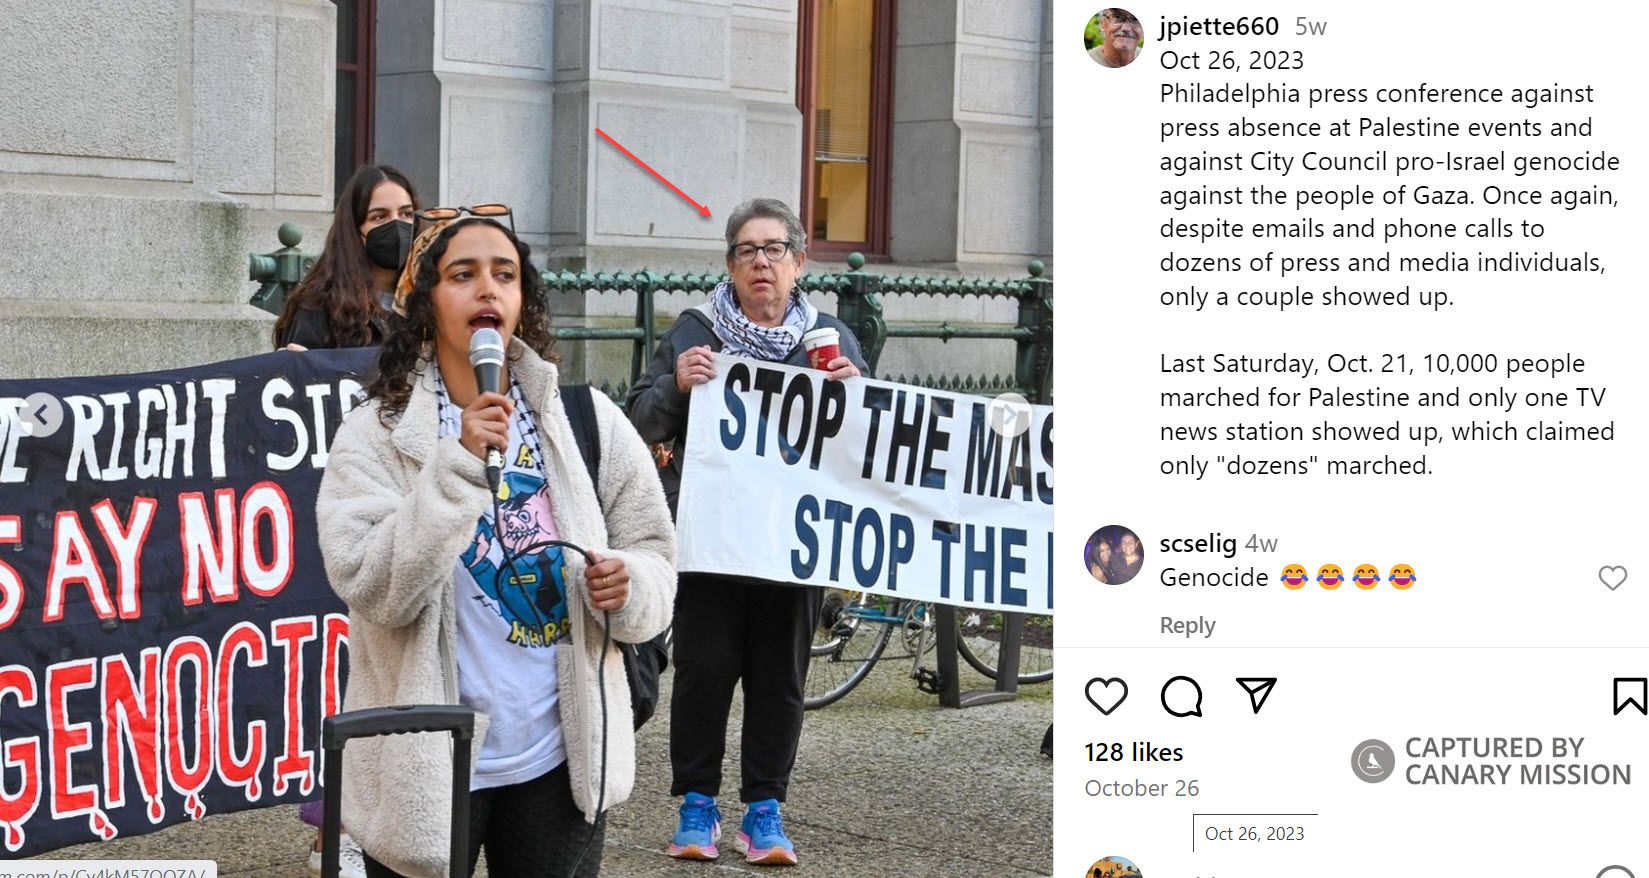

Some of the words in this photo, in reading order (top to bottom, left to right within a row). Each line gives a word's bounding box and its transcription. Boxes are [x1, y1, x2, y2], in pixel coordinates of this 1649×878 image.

[64, 377, 237, 483] RIGHT
[719, 362, 847, 471] STOP
[861, 385, 955, 490] THE
[178, 481, 294, 606] NO
[790, 494, 915, 591] STOP
[932, 520, 1028, 607] THE
